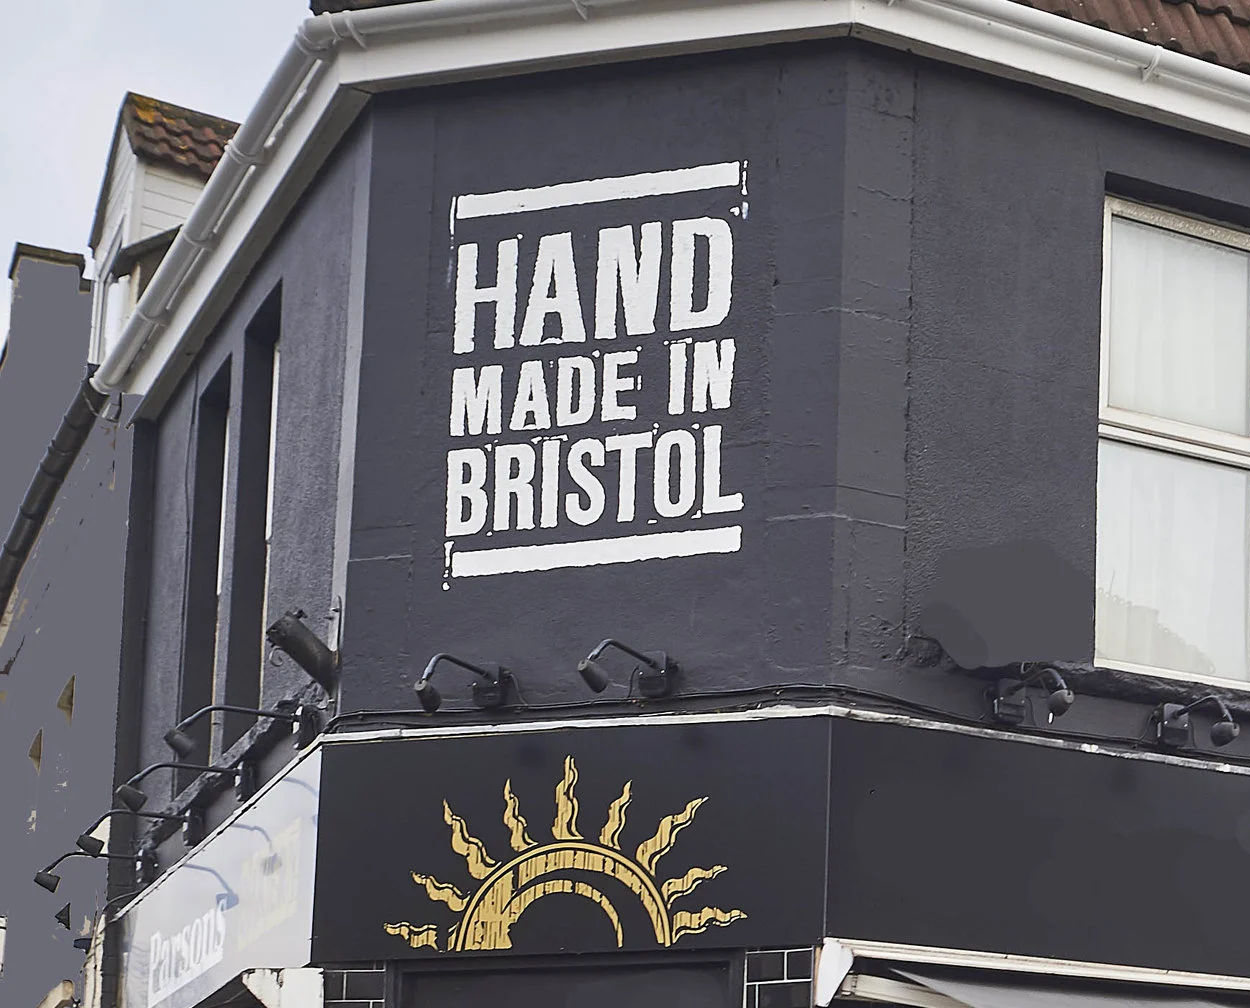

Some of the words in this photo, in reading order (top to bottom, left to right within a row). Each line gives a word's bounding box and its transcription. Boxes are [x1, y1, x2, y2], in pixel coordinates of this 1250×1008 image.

[453, 216, 735, 355] HAND
[450, 350, 640, 438] MADE
[668, 338, 737, 415] IN
[445, 424, 745, 538] BRISTOL
[148, 898, 228, 1000] Parsons
